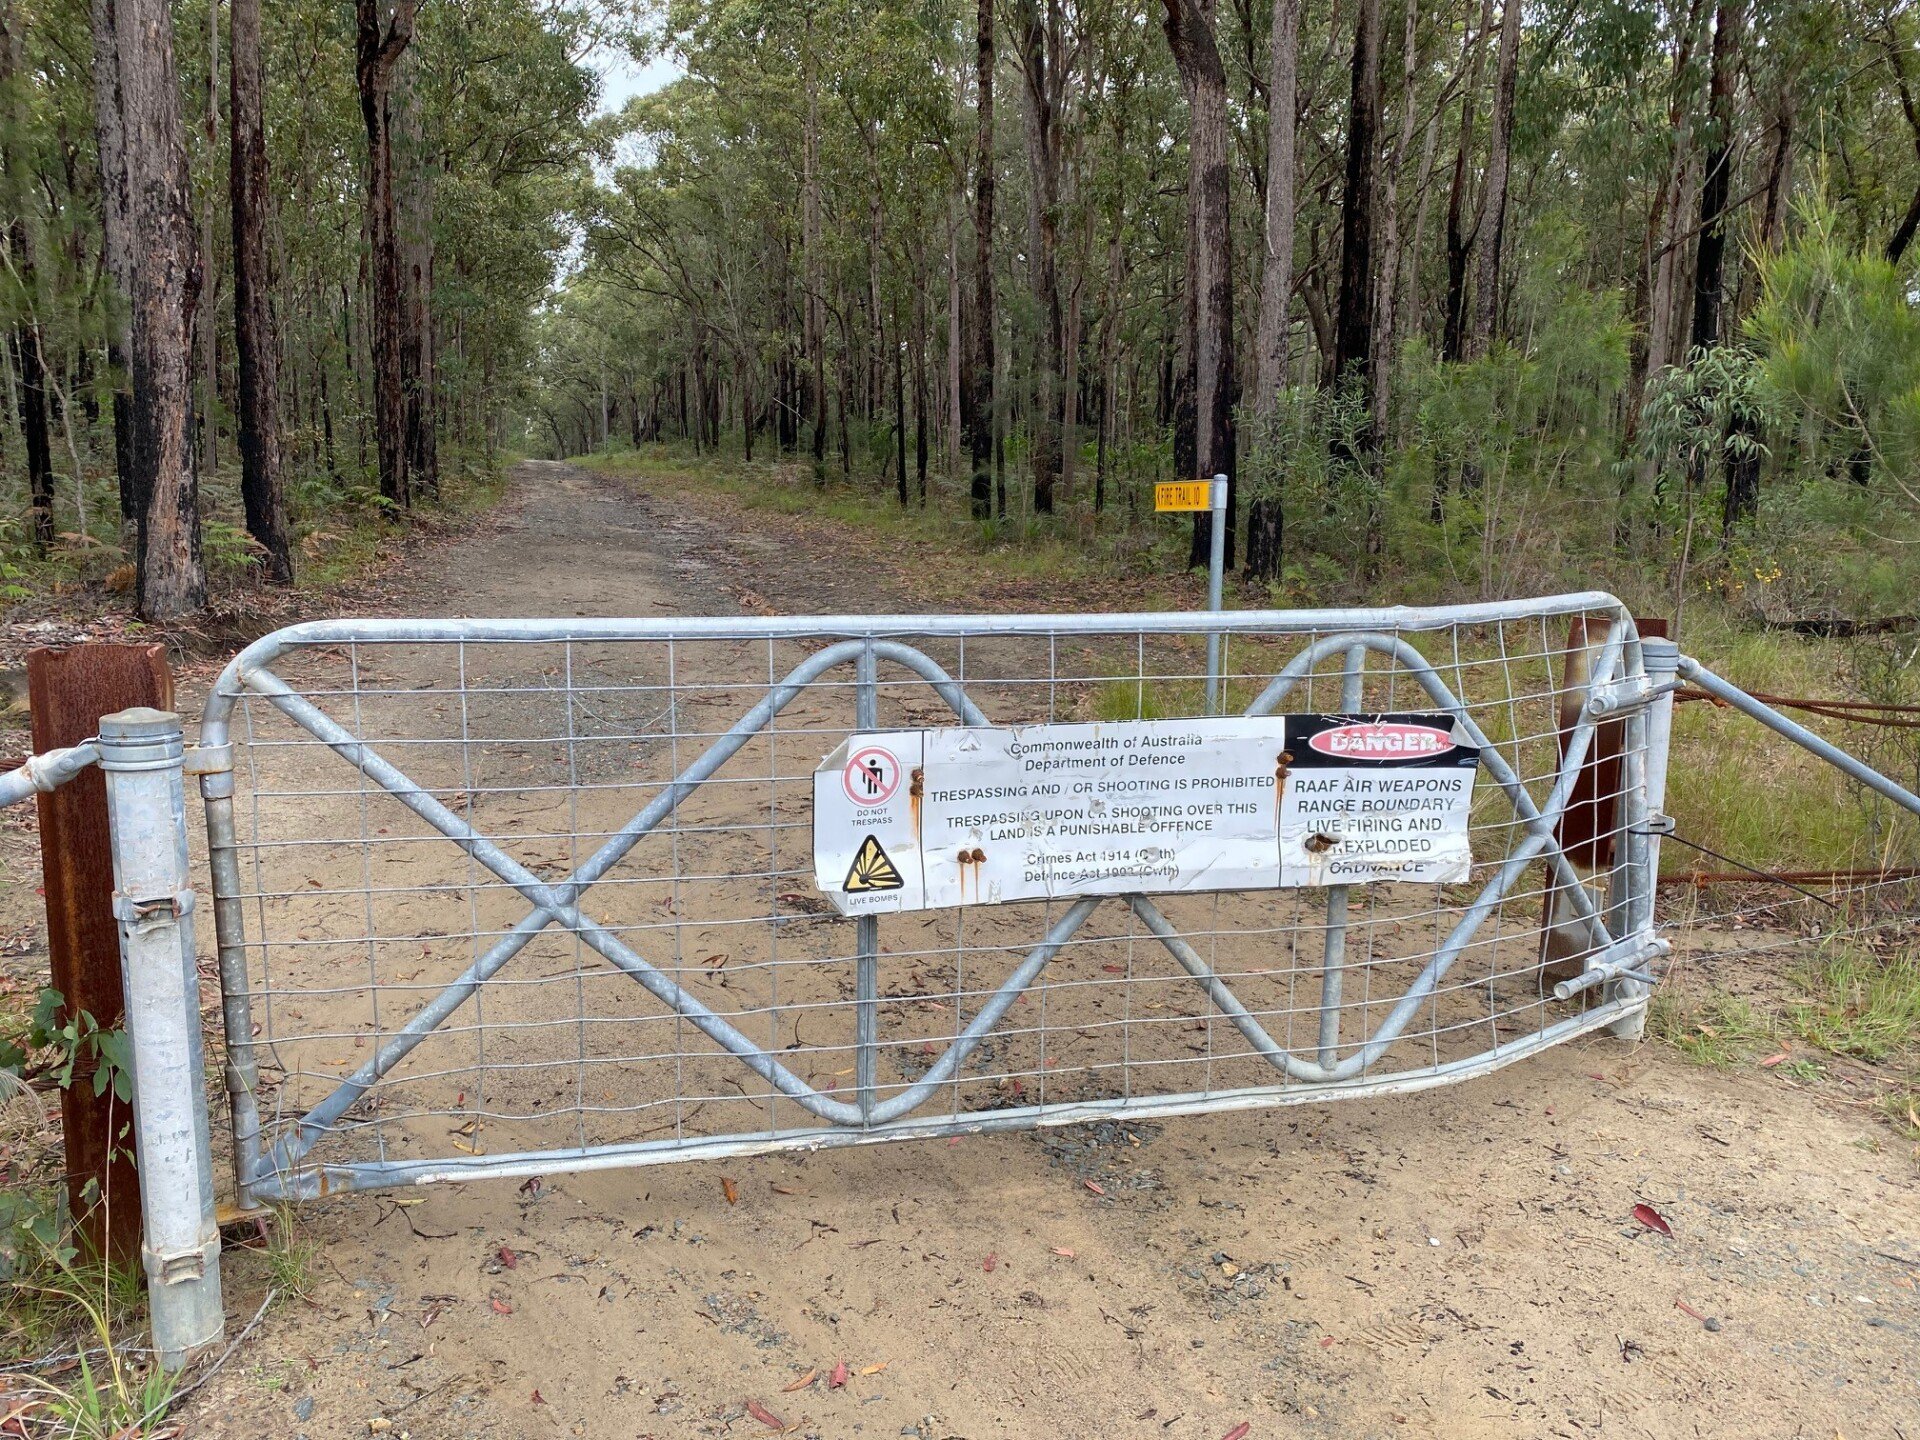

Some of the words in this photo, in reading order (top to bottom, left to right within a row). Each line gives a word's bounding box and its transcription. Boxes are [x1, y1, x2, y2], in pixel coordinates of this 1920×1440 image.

[1010, 737, 1118, 755] Commonwealth
[1123, 736, 1137, 748] of
[1141, 732, 1202, 748] Australia
[1330, 732, 1437, 752] DANGER
[1025, 754, 1106, 772] Department
[1110, 754, 1124, 767] of
[1128, 753, 1186, 767] Defence
[931, 787, 1028, 802] TRESPASSING
[1031, 784, 1061, 797] AND
[1073, 782, 1093, 794] OR
[1098, 779, 1170, 793] SHOOTING
[1174, 778, 1188, 791] IS
[1191, 776, 1275, 790] PROHIBITED
[1295, 779, 1340, 793] RAAF
[1343, 779, 1372, 793] AIR
[1378, 779, 1462, 793] WEAPONS
[857, 809, 869, 817] DO
[871, 808, 888, 816] NOT
[1297, 799, 1356, 813] RANGE
[1361, 798, 1455, 812] BOUNDARY
[852, 817, 893, 827] TRESPASS
[946, 811, 1040, 829] TRESPASSING
[1045, 809, 1084, 821] UPON
[1111, 805, 1183, 819] SHOOTING
[1187, 804, 1223, 816] OVER
[1228, 803, 1257, 815] THIS
[990, 828, 1026, 841] LAND
[1029, 826, 1042, 837] IS
[1046, 826, 1056, 837] A
[1060, 822, 1146, 836] PUNISHABLE
[1150, 820, 1213, 833] OFFENCE
[1307, 819, 1341, 833] LIVE
[1347, 818, 1402, 832] FIRING
[1408, 818, 1442, 831] AND
[1027, 853, 1072, 865] Crimes
[1075, 851, 1097, 863] Act
[1102, 850, 1131, 862] 1914
[1135, 848, 1176, 862] (Cth)
[1080, 869, 1100, 879] Act
[1139, 865, 1180, 880] (Cwth)
[850, 897, 867, 906] LIVE
[869, 895, 898, 904] BOMBS
